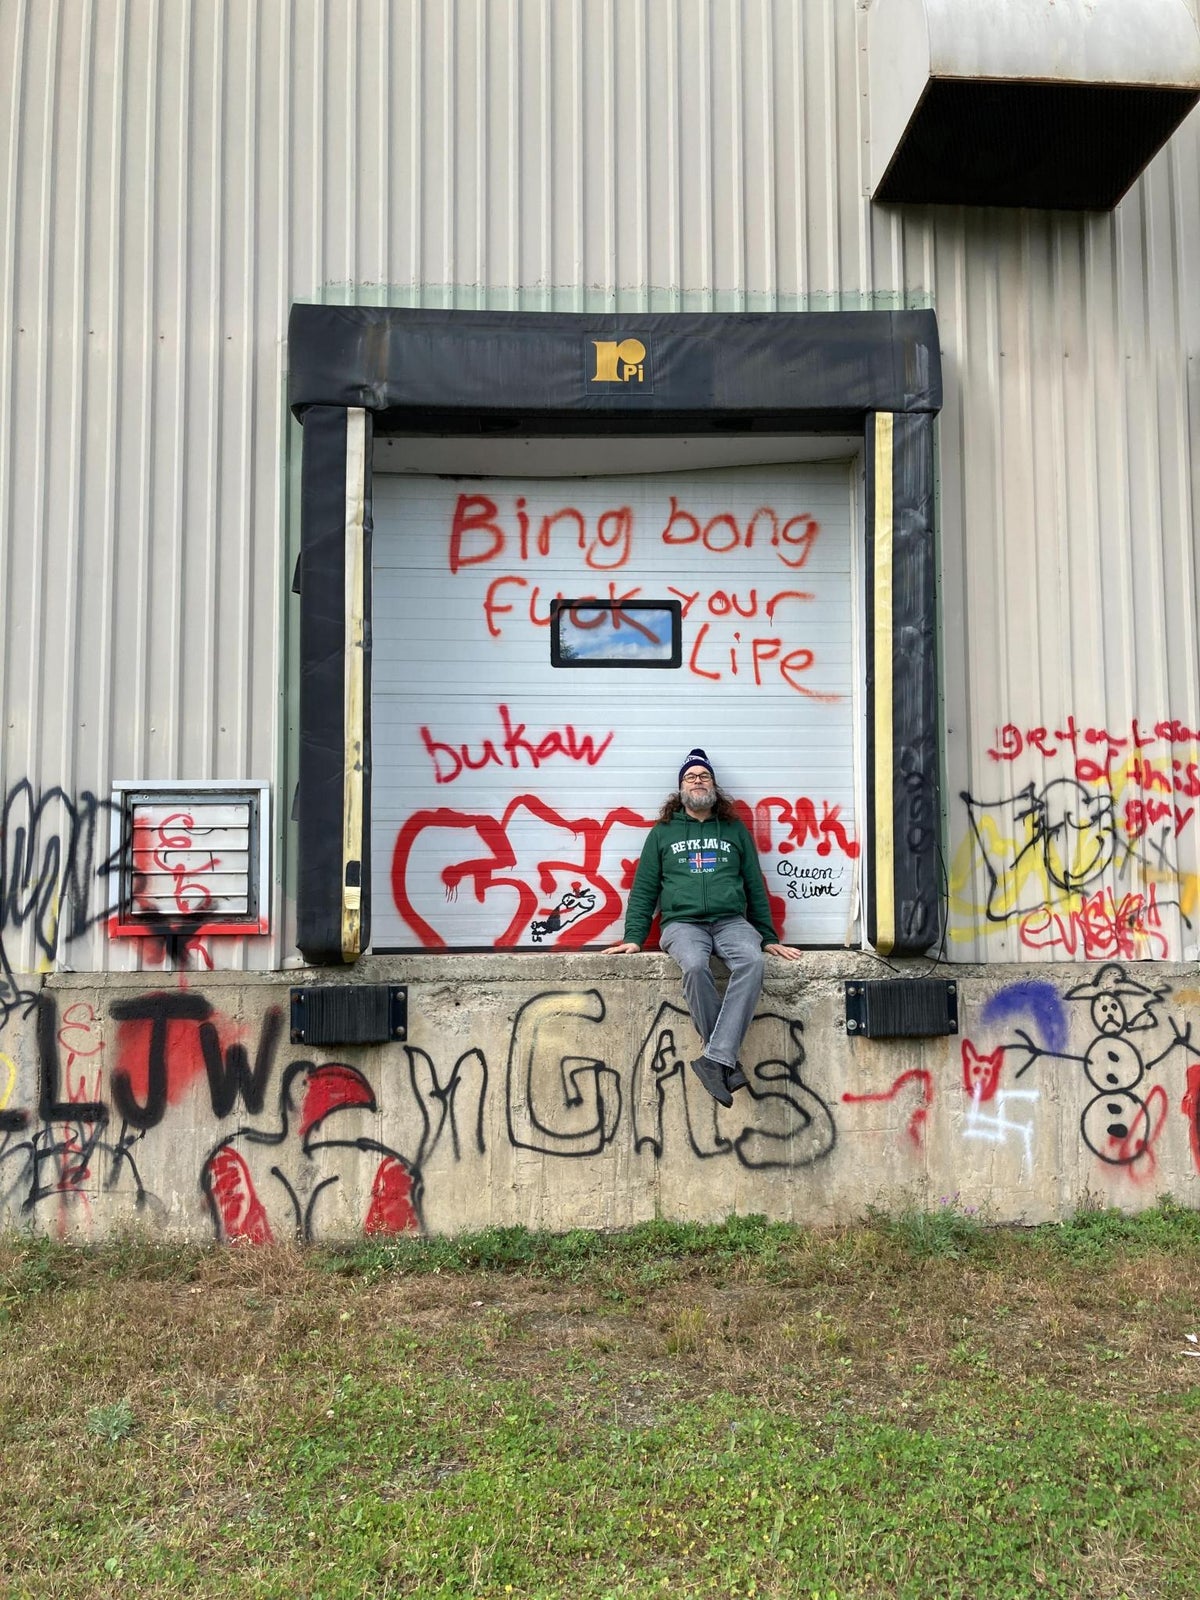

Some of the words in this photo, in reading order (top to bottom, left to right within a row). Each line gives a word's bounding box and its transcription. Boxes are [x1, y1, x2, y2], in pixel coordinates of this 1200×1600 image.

[449, 493, 632, 574] Bing
[662, 496, 821, 568] bong
[667, 586, 815, 626] your
[670, 838, 732, 854] REYKJAVIK
